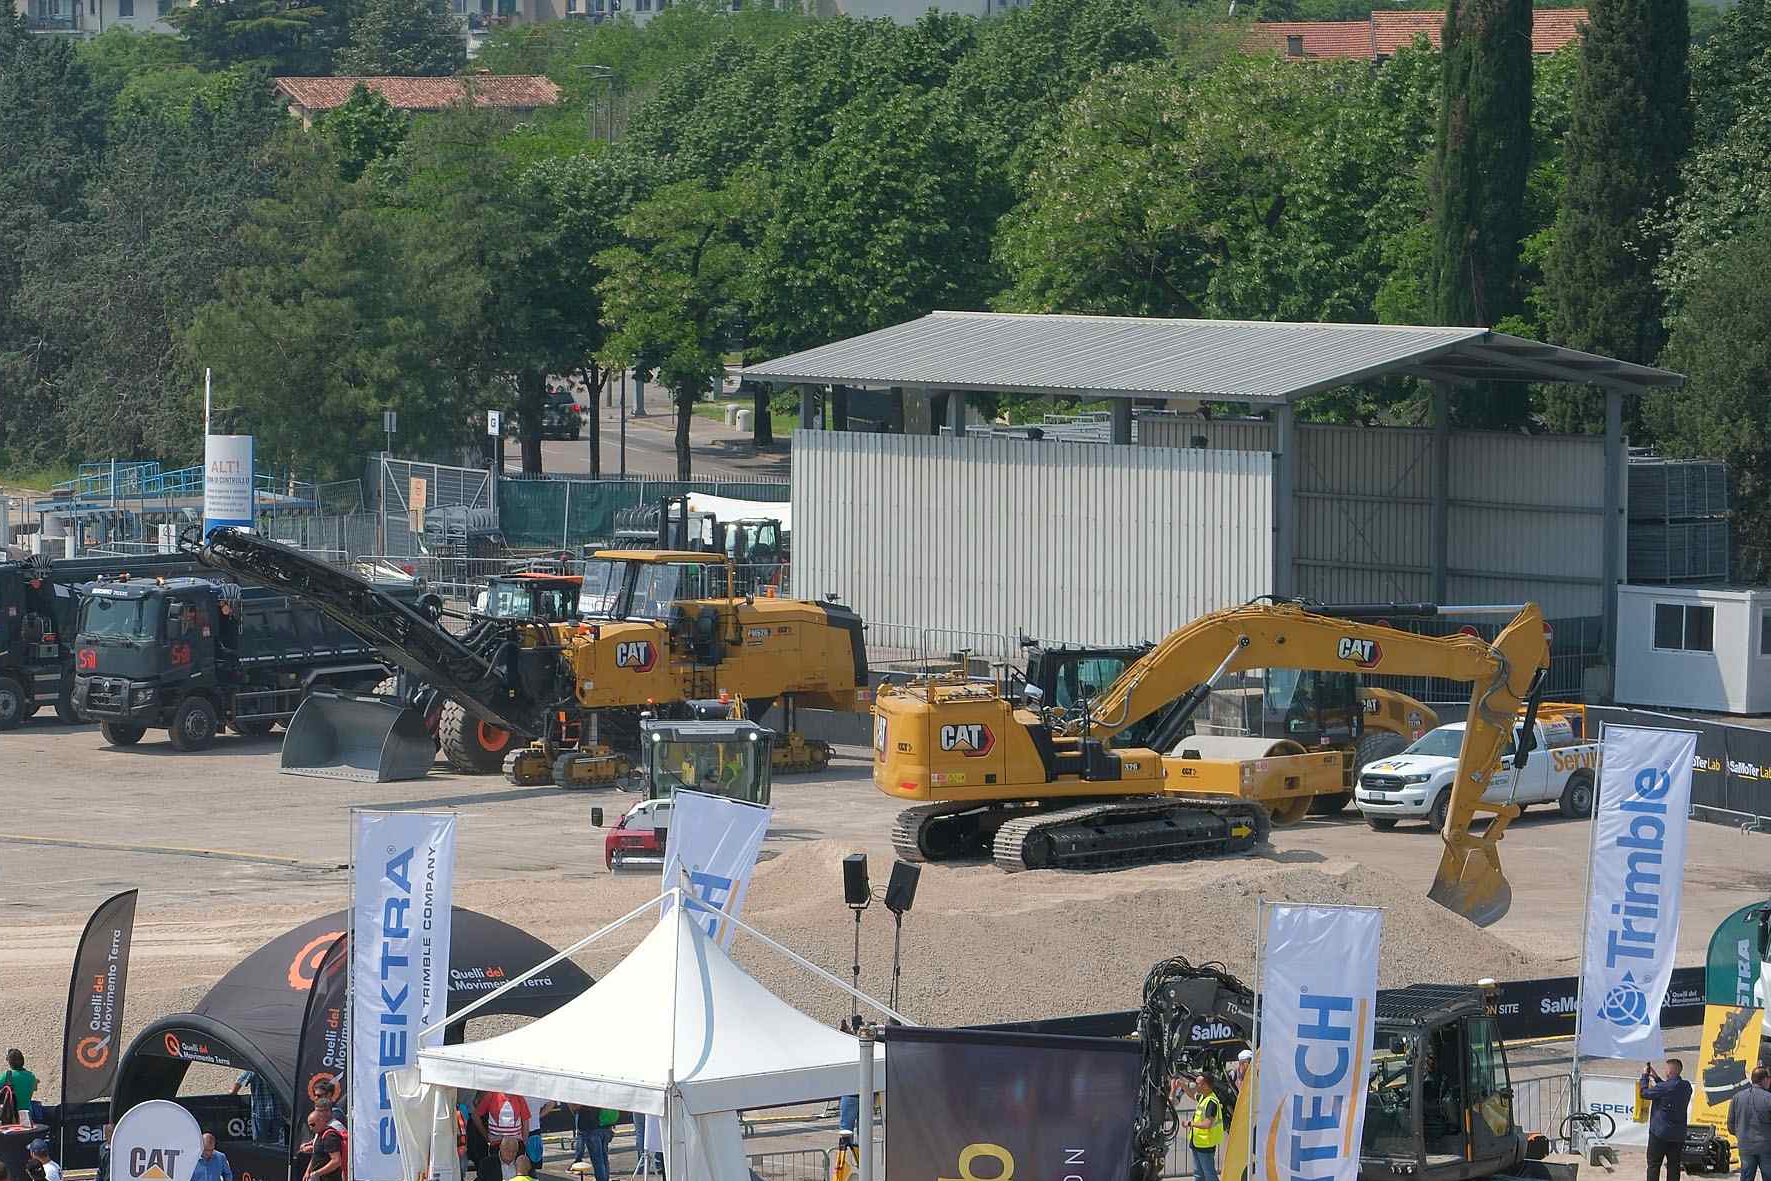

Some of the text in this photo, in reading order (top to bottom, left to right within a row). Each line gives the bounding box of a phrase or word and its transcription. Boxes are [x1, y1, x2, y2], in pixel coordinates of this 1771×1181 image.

[616, 641, 647, 667] CAT
[1338, 638, 1374, 662] CAT
[940, 725, 982, 751] CAT
[1606, 768, 1671, 968] Trimble
[423, 846, 436, 931] COMPANY
[101, 929, 122, 1033] Movimento Terra
[422, 937, 431, 1008] TRIMBLE
[450, 966, 505, 981] Quelli del
[90, 975, 106, 1031] Quelli del
[1498, 1003, 1520, 1014] SITE
[323, 1030, 337, 1067] Quelli
[129, 1147, 180, 1180] CAT
